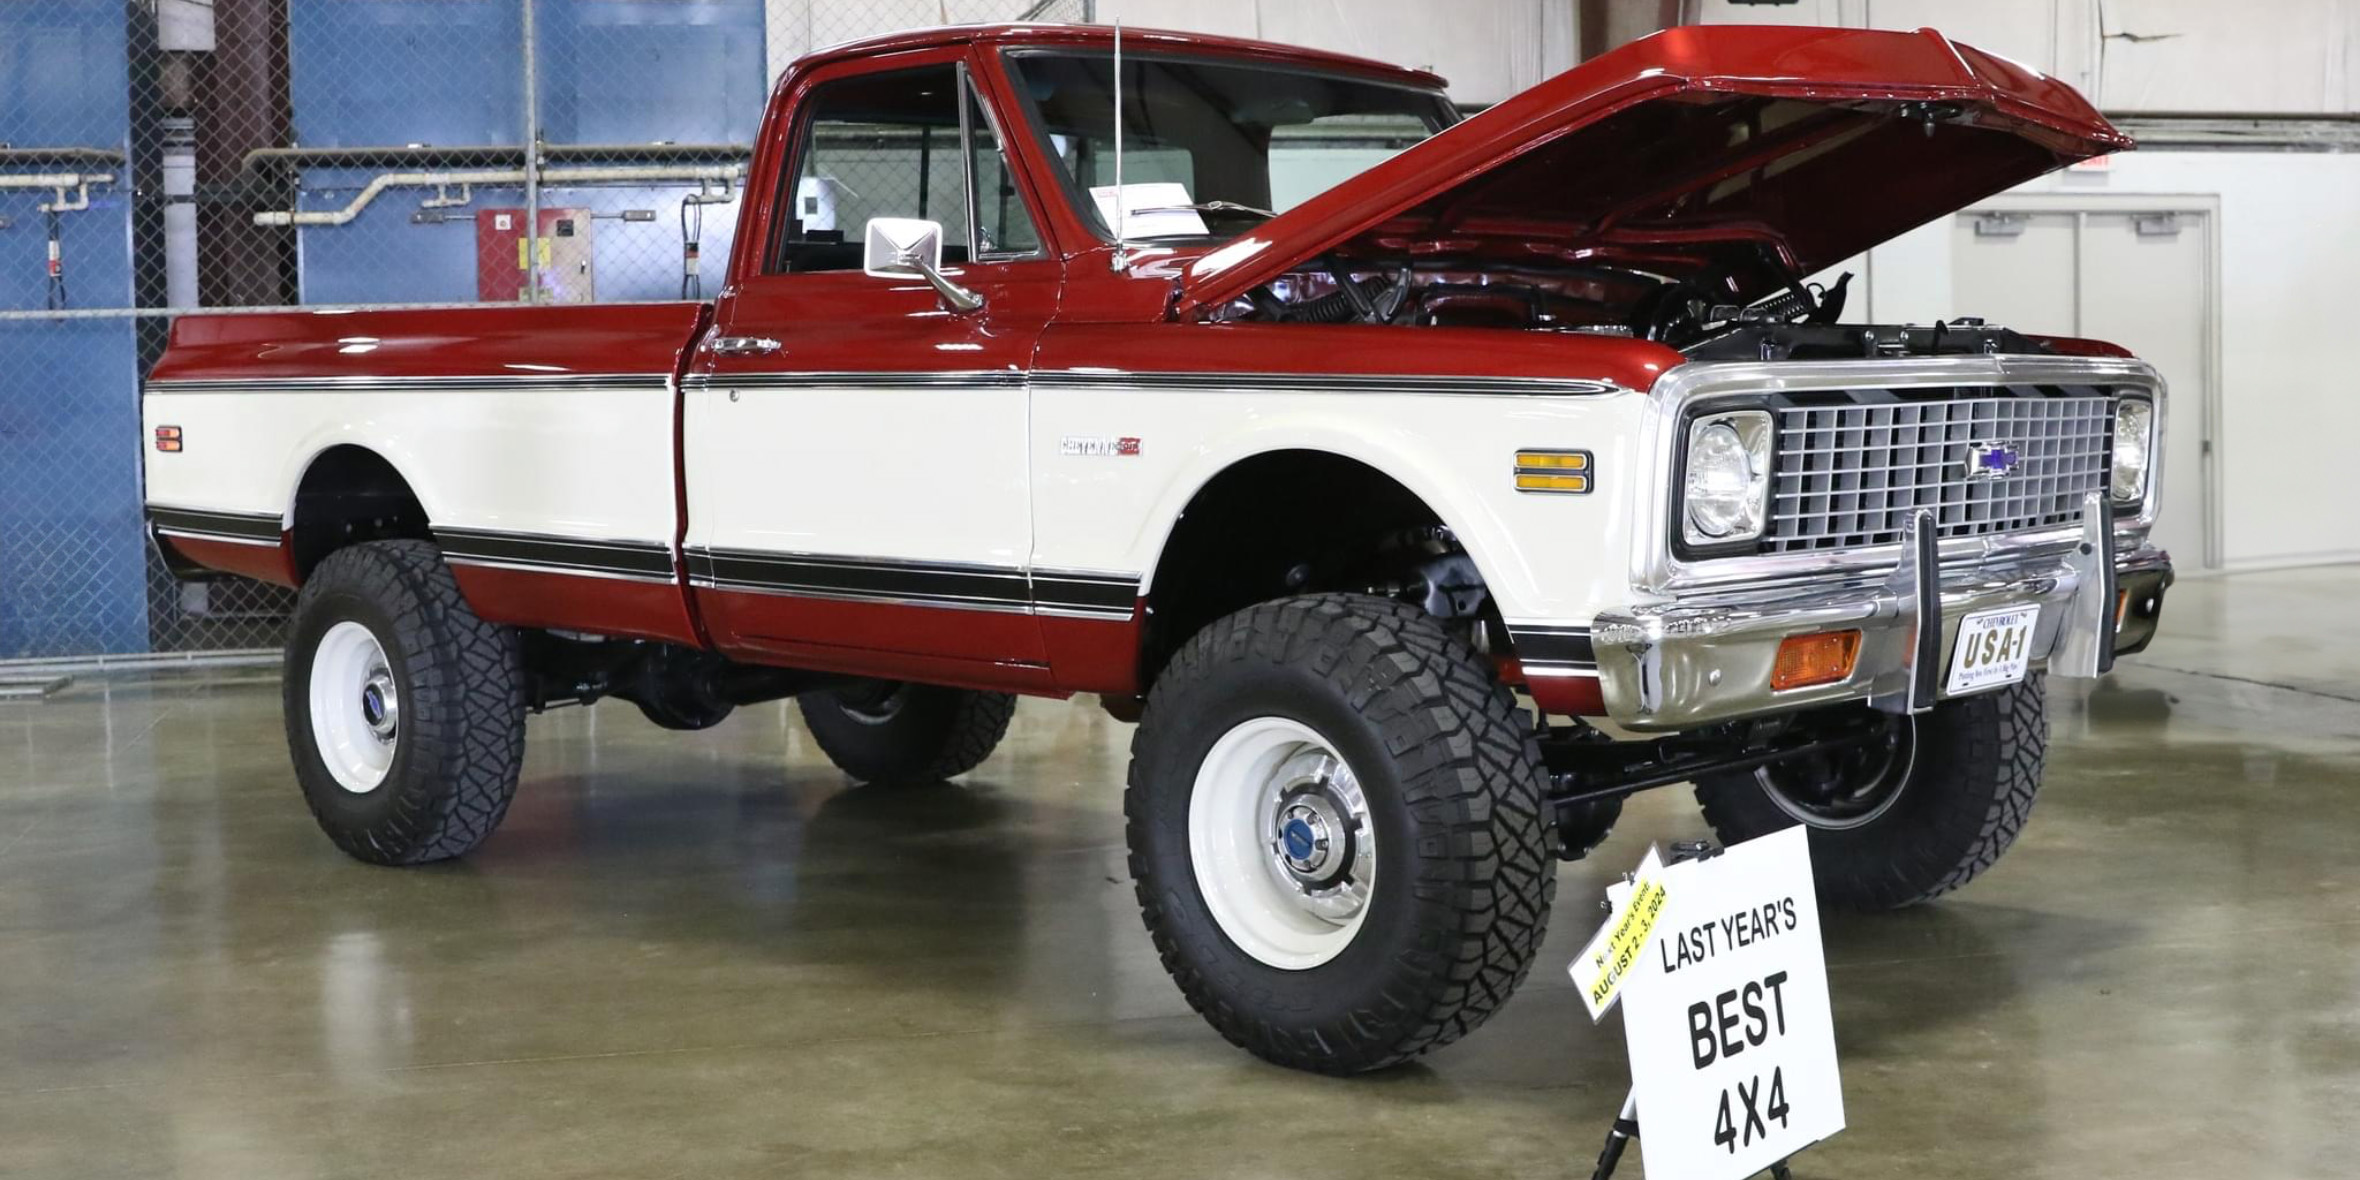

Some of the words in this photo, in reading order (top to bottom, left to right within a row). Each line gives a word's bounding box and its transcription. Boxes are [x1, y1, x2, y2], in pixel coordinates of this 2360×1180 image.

[1648, 886, 1666, 918] 2024
[1660, 922, 1716, 973] LAST
[1721, 897, 1797, 951] YEAR'S
[1688, 971, 1787, 1070] BEST
[1714, 1066, 1789, 1154] 4X4
